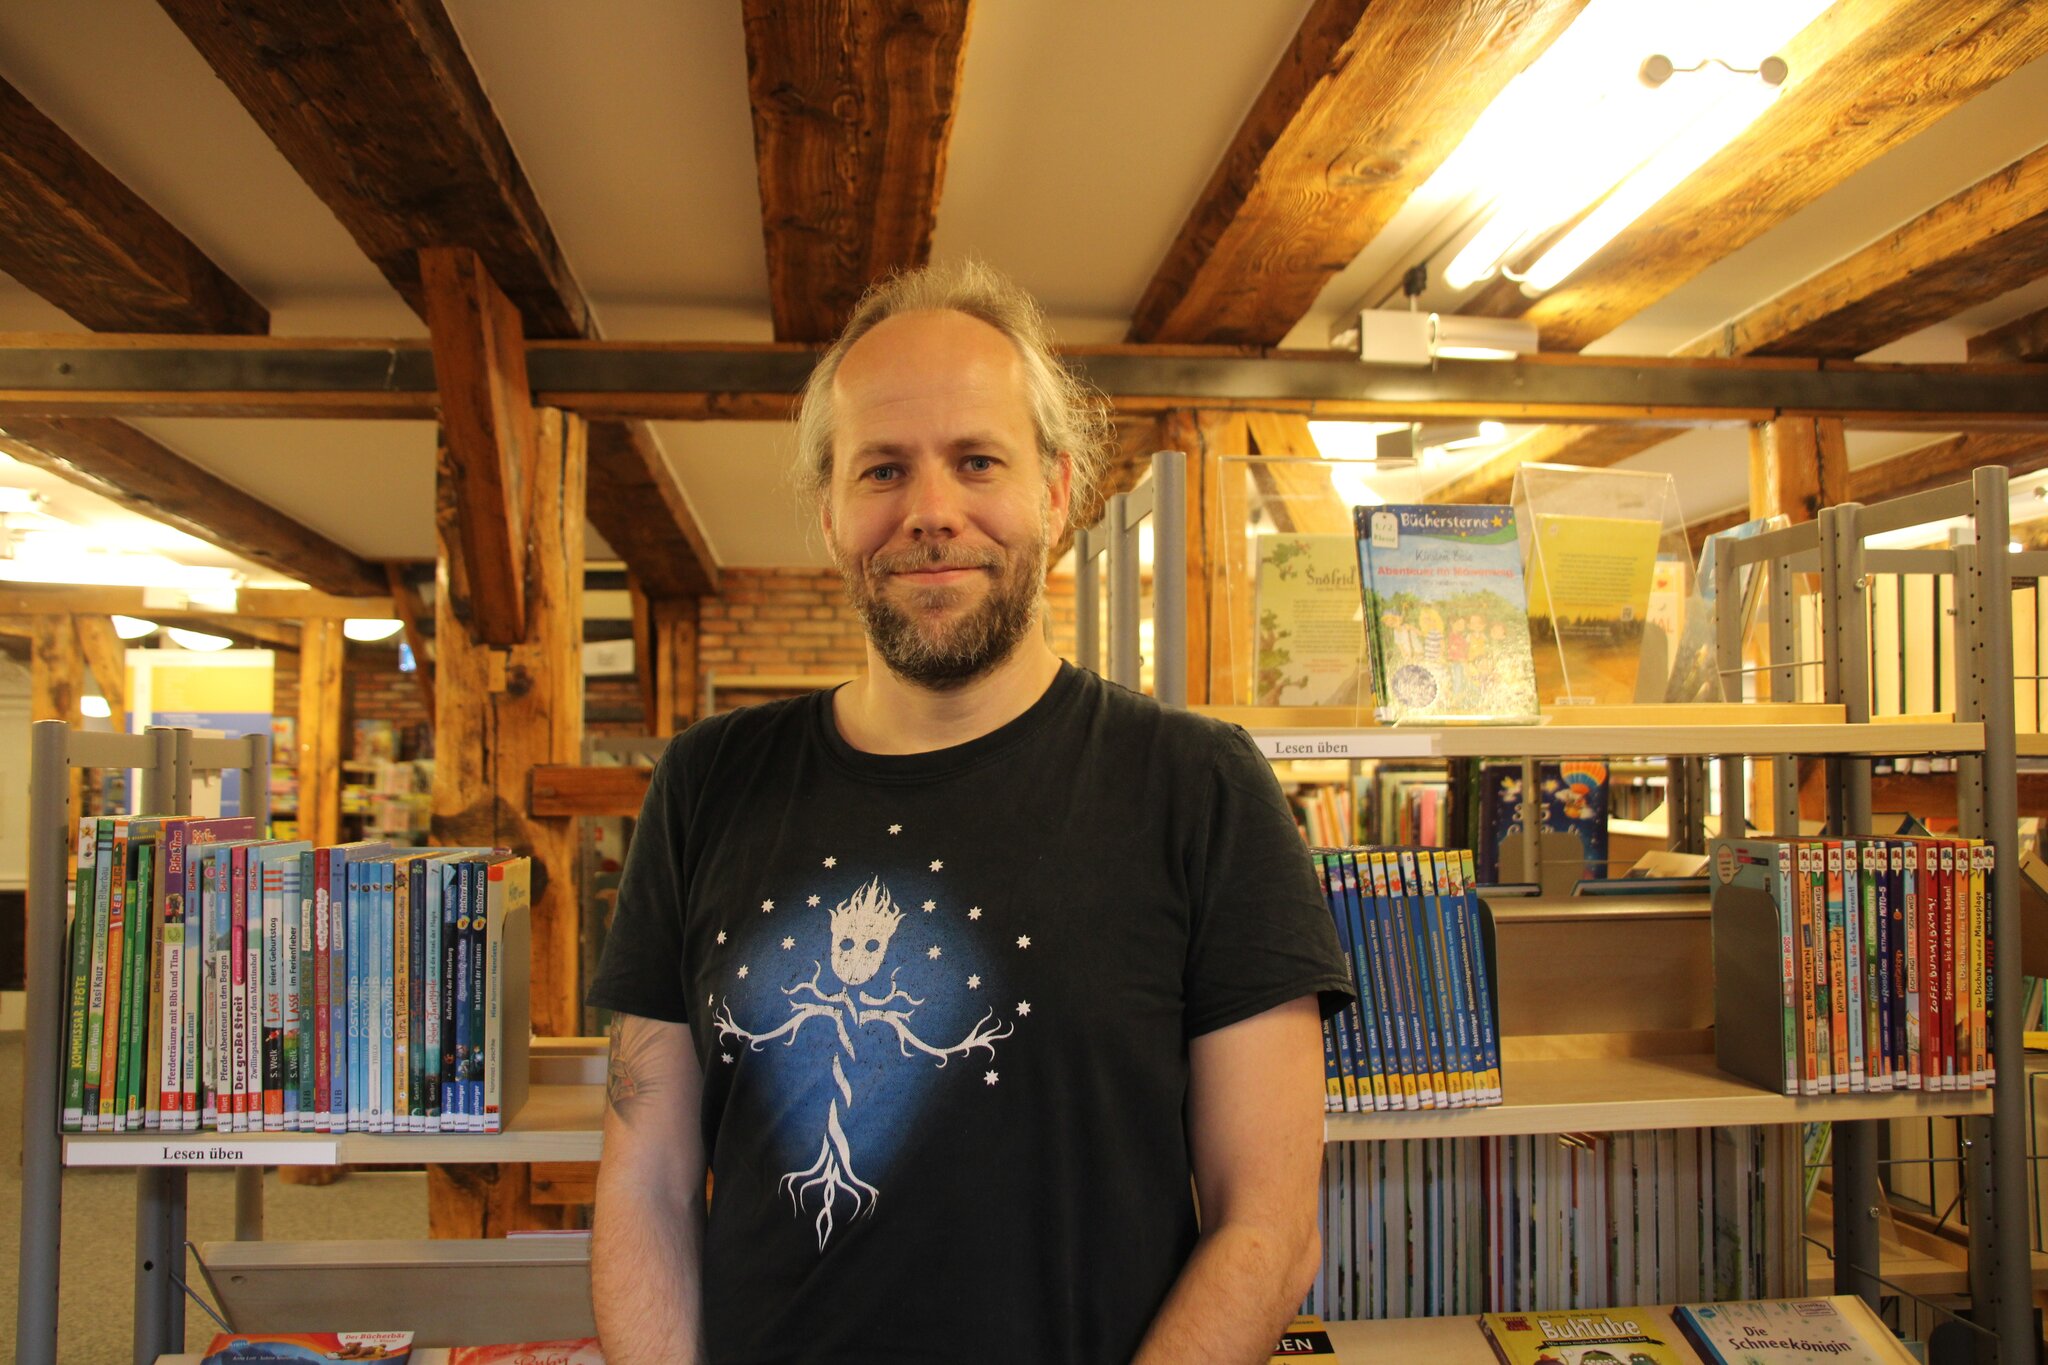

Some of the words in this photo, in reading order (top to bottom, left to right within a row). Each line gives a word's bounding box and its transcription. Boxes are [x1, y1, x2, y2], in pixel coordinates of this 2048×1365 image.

[1400, 511, 1489, 529] Büchersterne
[1378, 565, 1433, 577] Abenteuer
[1275, 741, 1314, 754] Lesen
[1317, 741, 1349, 754] üben
[99, 866, 109, 900] Biberbau
[112, 866, 123, 915] LESEZUG
[99, 901, 107, 913] am
[1848, 886, 1856, 912] brennt!
[1975, 892, 1983, 937] Mäuseplage
[96, 915, 106, 938] Radau
[1928, 897, 1936, 936] BÄMM!
[269, 917, 279, 962] Geburtstag
[288, 926, 298, 974] Ferienfieber
[1432, 931, 1444, 979] Glücksschwein
[1471, 913, 1483, 976] Weihnachtsschwein
[170, 950, 179, 968] Tina
[220, 955, 229, 982] Bergen
[250, 953, 258, 994] Martinshof
[446, 948, 454, 979] Ritterburg
[1358, 943, 1367, 975] Weltraum
[1401, 932, 1417, 1014] Freundschaftsgeschichten
[1461, 938, 1475, 1011] Weihnachtsgeschichten
[1929, 940, 1937, 978] BUMM!
[1959, 945, 1967, 978] Dschuha
[93, 966, 103, 988] Kauz
[268, 964, 278, 986] feiert
[290, 975, 296, 986] im
[1375, 953, 1389, 1012] Feriengeschichten
[1851, 976, 1859, 1003] Fackeln
[92, 989, 101, 1008] Kasi
[234, 996, 243, 1029] Streit
[266, 993, 280, 1022] LASSE
[286, 993, 300, 1022] LASSE
[349, 975, 359, 1038] OSTWIND
[383, 976, 393, 1038] OSTWIND
[1929, 982, 1938, 1013] ZOFF!
[169, 1009, 177, 1024] mit
[1384, 1015, 1393, 1048] Nöstlinger
[1399, 1015, 1407, 1048] Nöstlinger
[1457, 1012, 1466, 1046] Nöstlinger
[1470, 1014, 1480, 1046] Nöstlinger
[71, 1010, 84, 1068] KOMMISSAR
[220, 1011, 229, 1081] Pferde-Abenteuer
[1413, 1017, 1422, 1050] Nöstlinger
[89, 1048, 99, 1072] Oliver
[168, 1026, 178, 1086] Pferdeträume
[186, 1056, 195, 1079] Hilfe,
[250, 1025, 259, 1079] Zwillingsalarm
[235, 1070, 244, 1090] Der
[270, 1070, 277, 1078] S.
[291, 1070, 297, 1078] S.
[302, 1090, 311, 1108] KJB
[334, 1089, 342, 1107] KJB
[163, 1146, 204, 1160] Lesen
[209, 1146, 243, 1160] üben
[1537, 1316, 1641, 1339] BuhTube
[1743, 1326, 1768, 1337] Die
[1729, 1337, 1852, 1355] Schneekönigin
